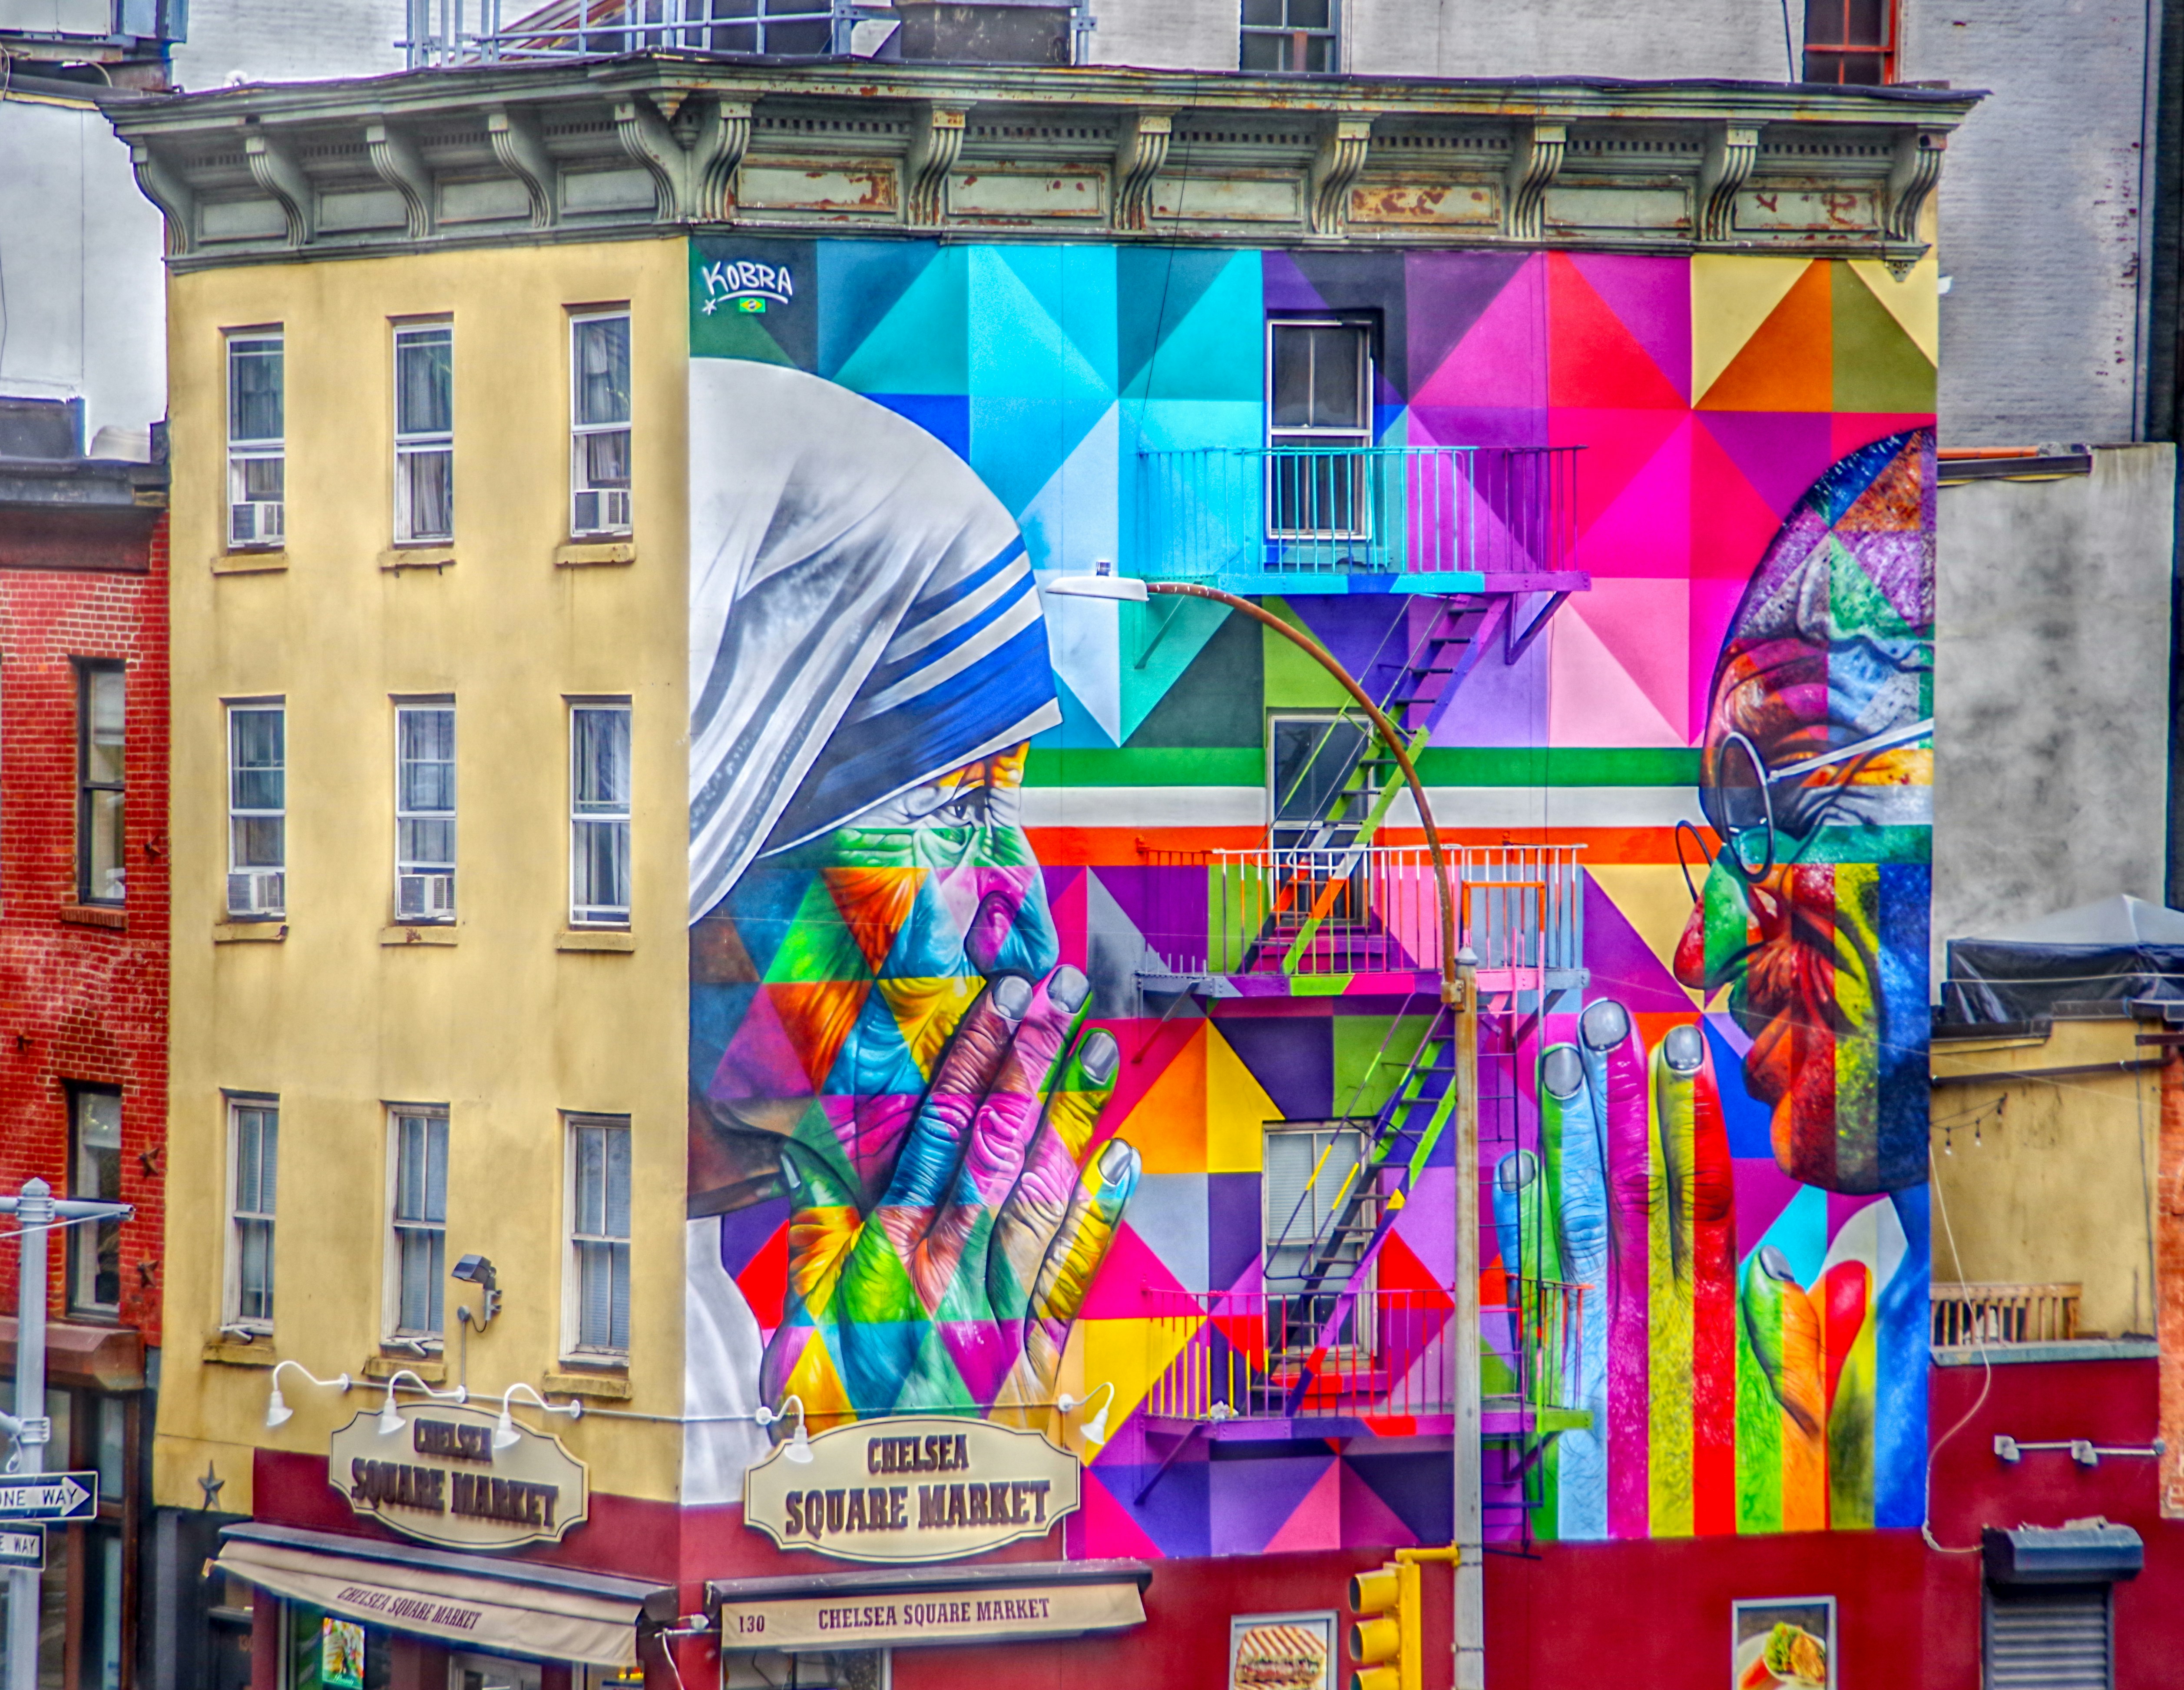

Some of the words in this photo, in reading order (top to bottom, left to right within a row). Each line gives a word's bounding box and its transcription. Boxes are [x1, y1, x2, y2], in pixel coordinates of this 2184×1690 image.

[702, 261, 793, 296] KOBRA
[868, 1434, 970, 1474] CHELSEA
[0, 1489, 25, 1507] NE
[43, 1488, 77, 1505] WAY
[351, 1457, 445, 1511] SQUARE
[451, 1471, 559, 1527] MARKET
[785, 1485, 909, 1540] SQUARE
[918, 1479, 1051, 1528] MARKET
[14, 1536, 35, 1554] WAY
[337, 1587, 391, 1612] CHELSEA
[388, 1597, 434, 1618] SQUARE
[432, 1607, 482, 1630] MARKET
[739, 1615, 765, 1633] 130
[818, 1606, 898, 1630] CHELSEA
[903, 1601, 971, 1626] SQUARE
[977, 1597, 1050, 1622] MARKET
